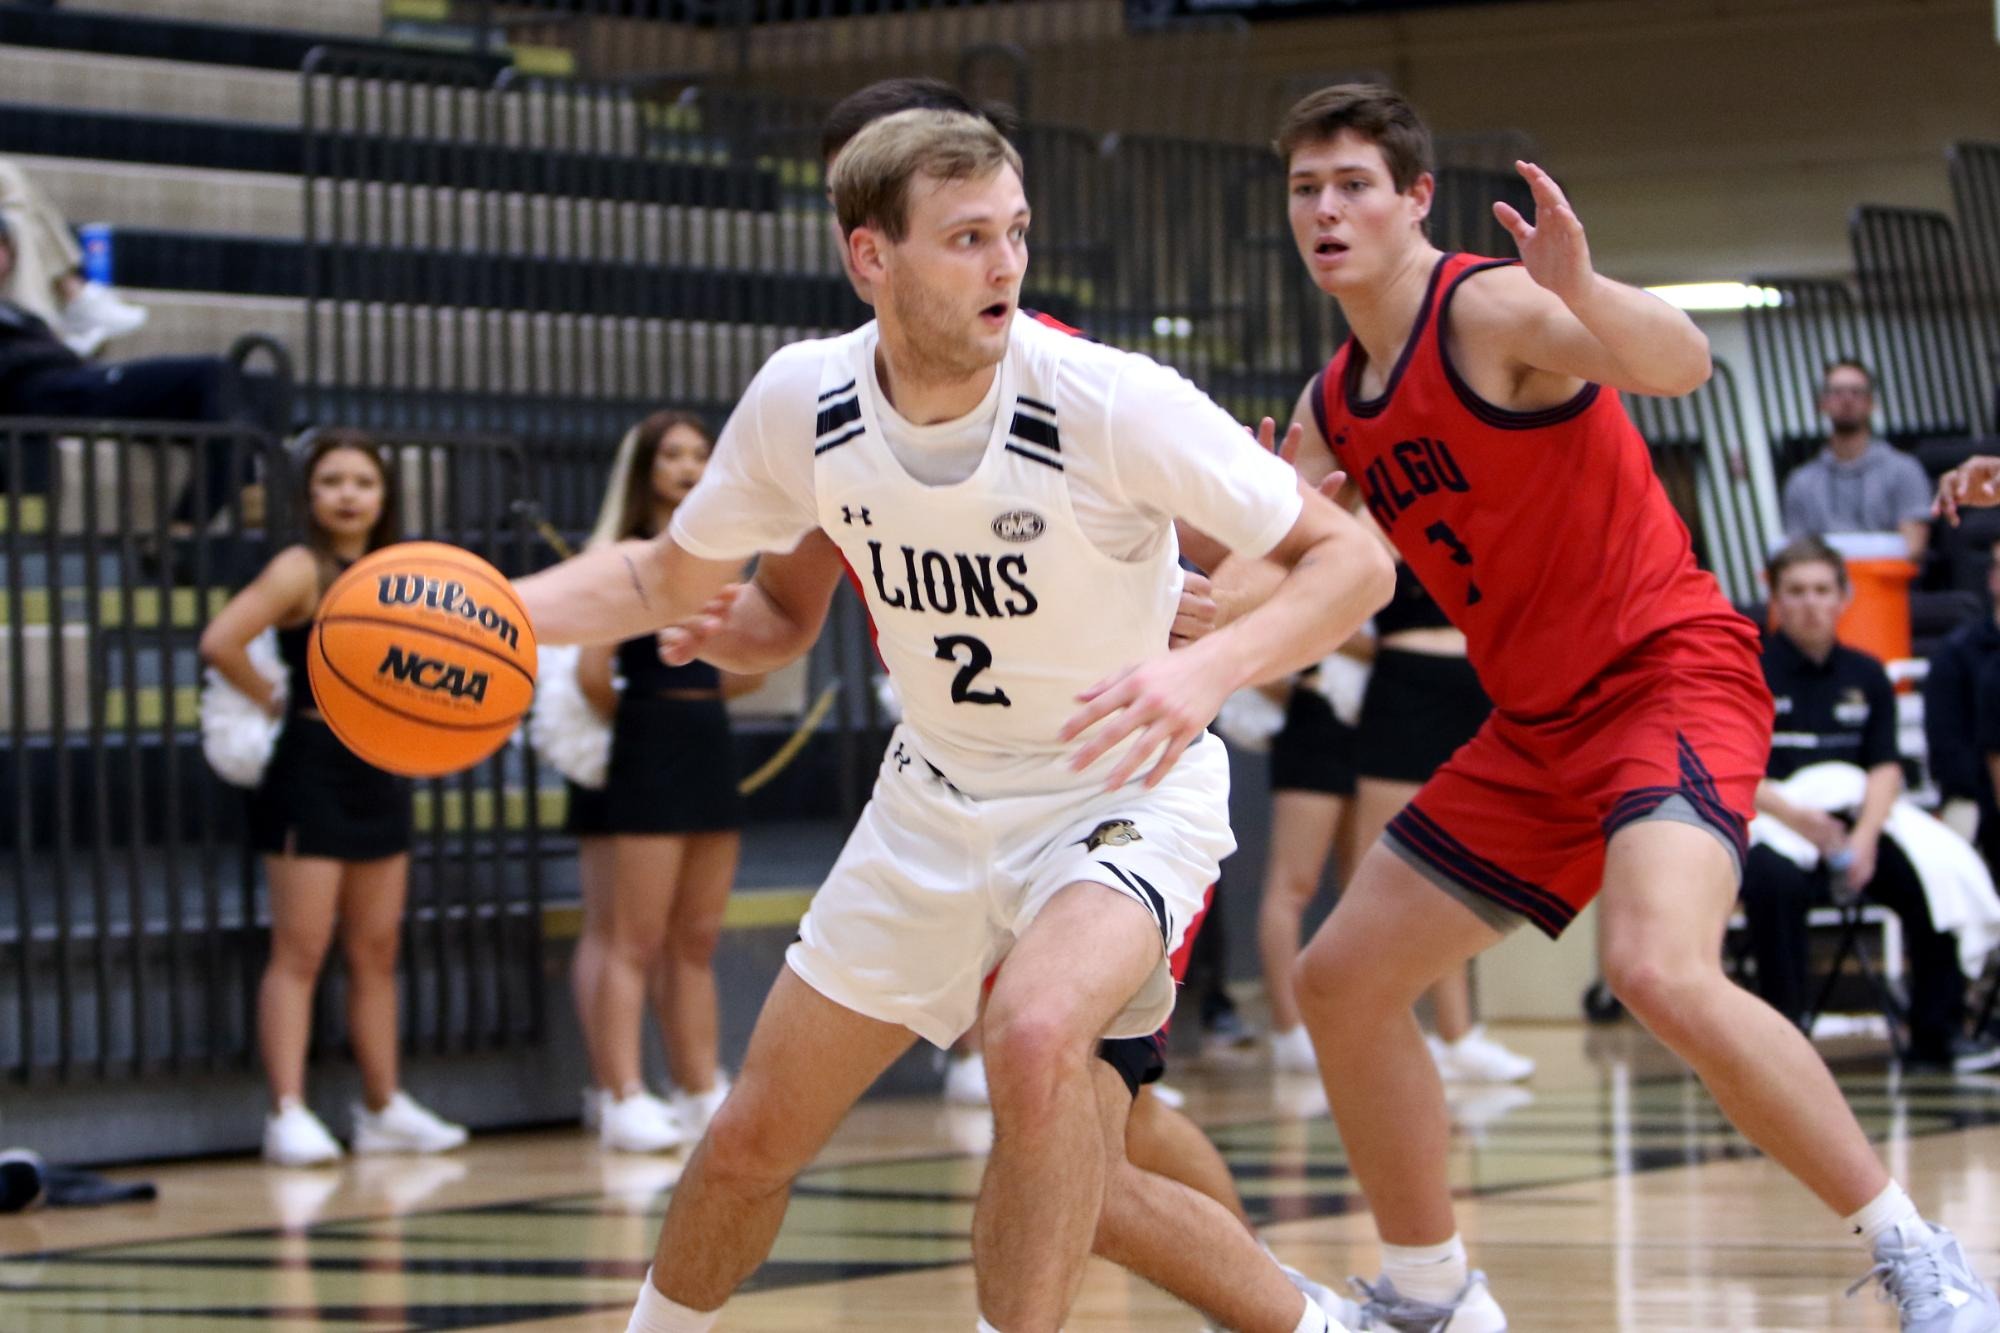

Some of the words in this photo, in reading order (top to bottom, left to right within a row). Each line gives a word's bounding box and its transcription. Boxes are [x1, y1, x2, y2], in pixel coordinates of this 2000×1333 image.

[1366, 437, 1471, 533] HLGU
[378, 573, 519, 650] Wilson
[867, 540, 1038, 618] LIONS
[379, 646, 489, 705] NCAA
[933, 634, 1012, 707] 2
